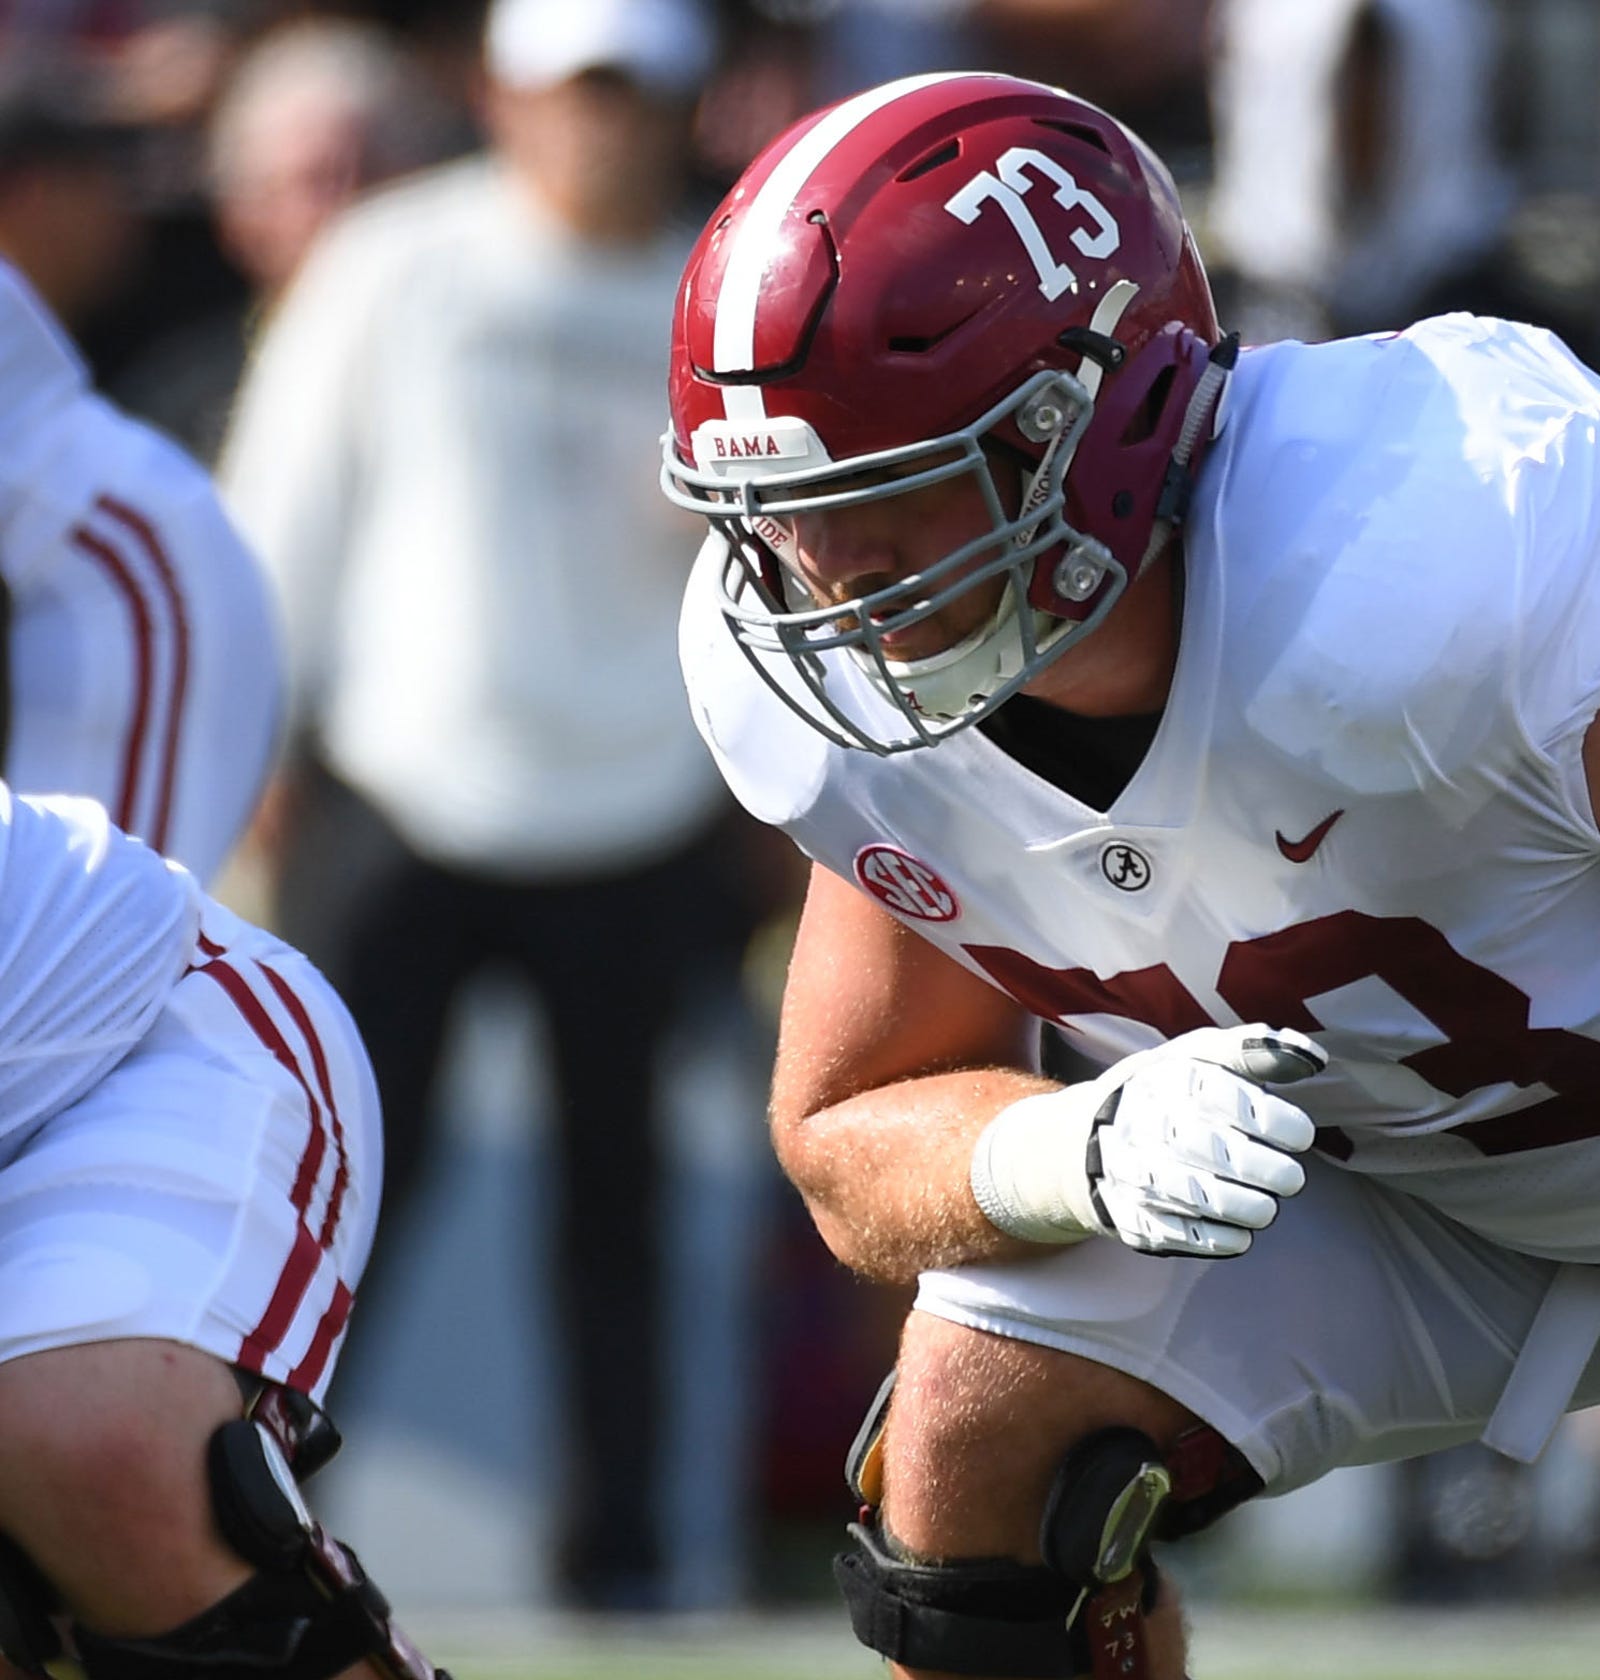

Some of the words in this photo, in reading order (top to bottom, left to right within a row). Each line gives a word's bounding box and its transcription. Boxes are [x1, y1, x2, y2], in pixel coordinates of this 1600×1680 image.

[944, 146, 1121, 301] 73
[713, 435, 781, 457] BAMA
[749, 515, 788, 549] IDE
[864, 848, 951, 918] SEC
[1105, 1632, 1135, 1658] 73
